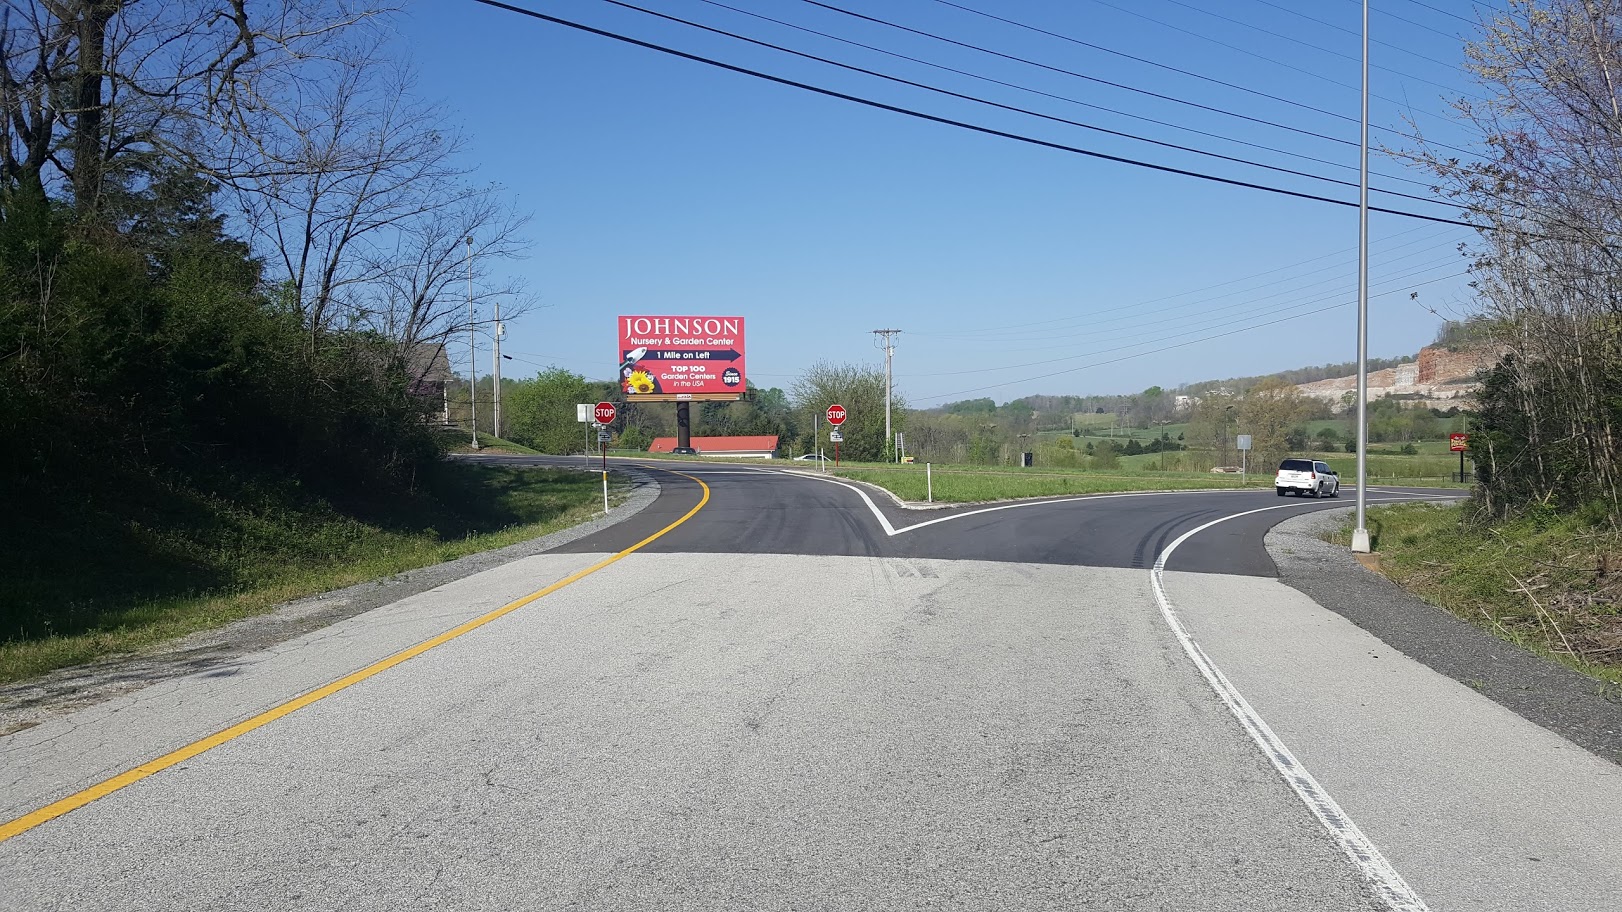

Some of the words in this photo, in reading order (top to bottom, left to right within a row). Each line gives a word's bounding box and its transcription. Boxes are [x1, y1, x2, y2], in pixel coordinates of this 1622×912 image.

[625, 318, 739, 339] JOHNSON
[631, 337, 662, 346] Nursery
[664, 337, 671, 345] &
[672, 337, 704, 345] Garden
[595, 408, 615, 418] STOP
